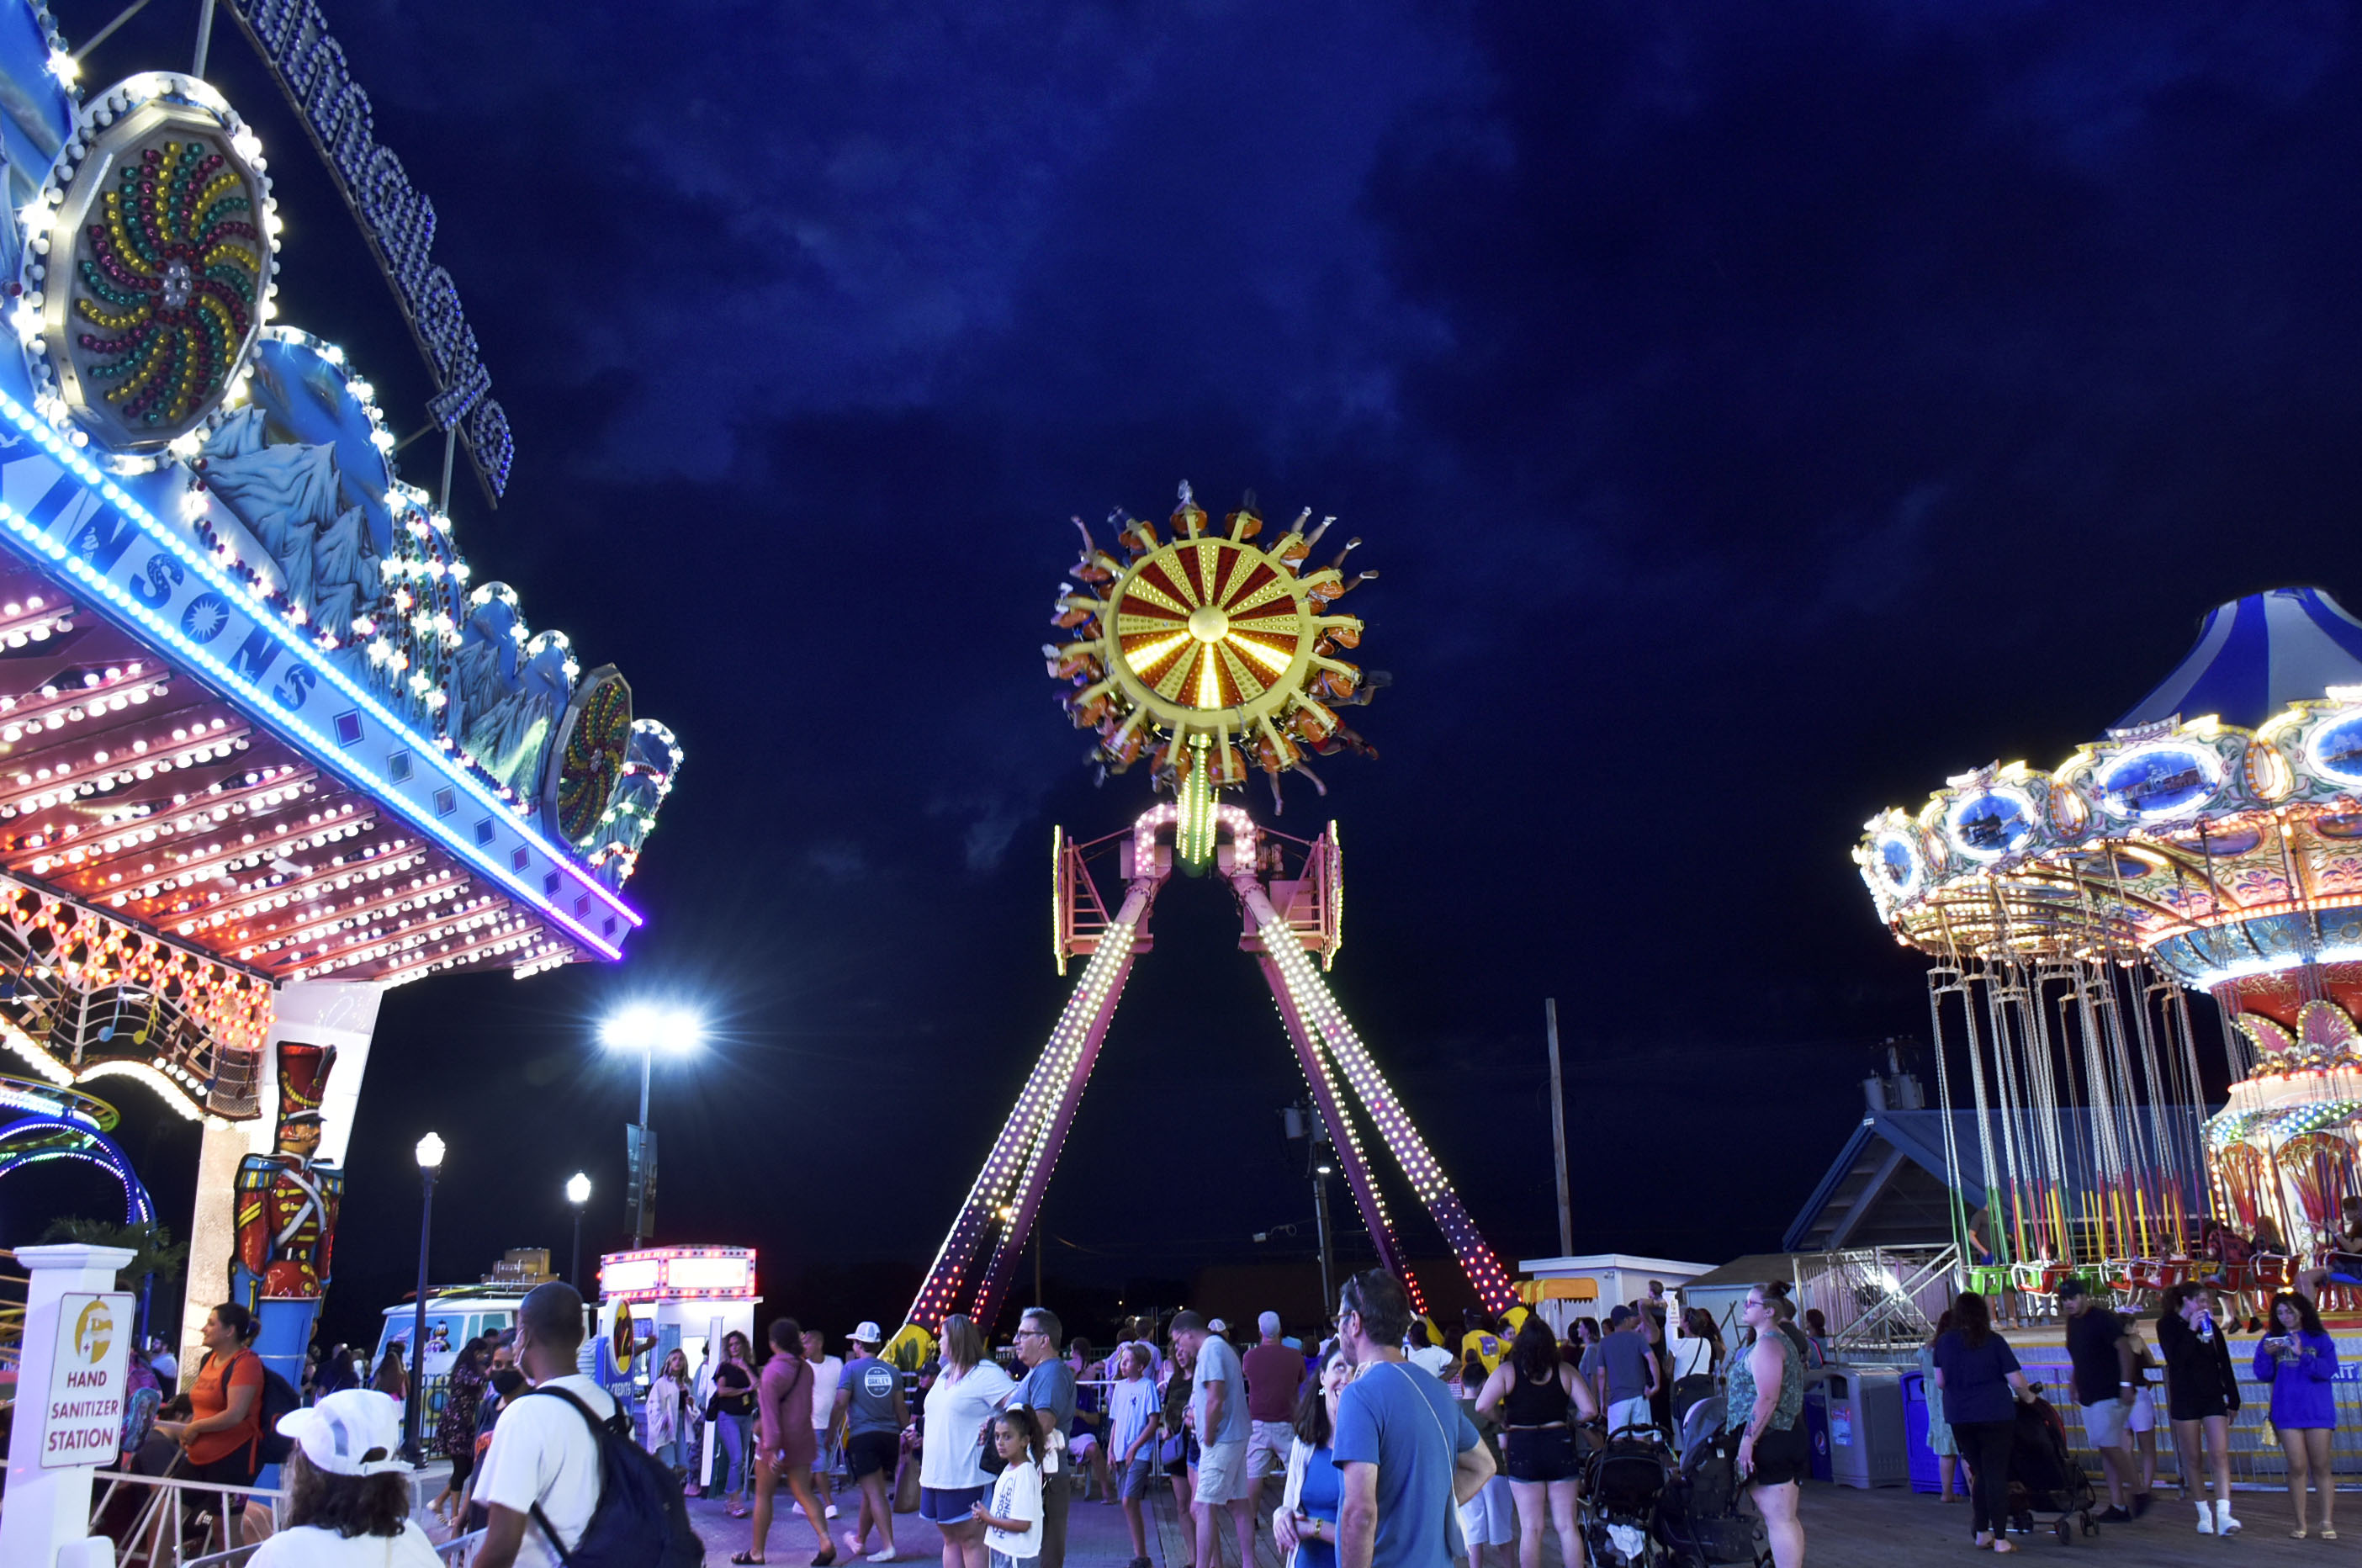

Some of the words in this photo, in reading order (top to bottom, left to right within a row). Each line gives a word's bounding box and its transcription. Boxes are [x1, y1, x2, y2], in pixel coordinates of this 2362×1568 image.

[66, 1370, 108, 1389] HAND
[51, 1400, 119, 1420] SANITIZER
[48, 1428, 114, 1452] STATION
[993, 1493, 1005, 1534] COOSE
[998, 1487, 1012, 1539] HPINESS
